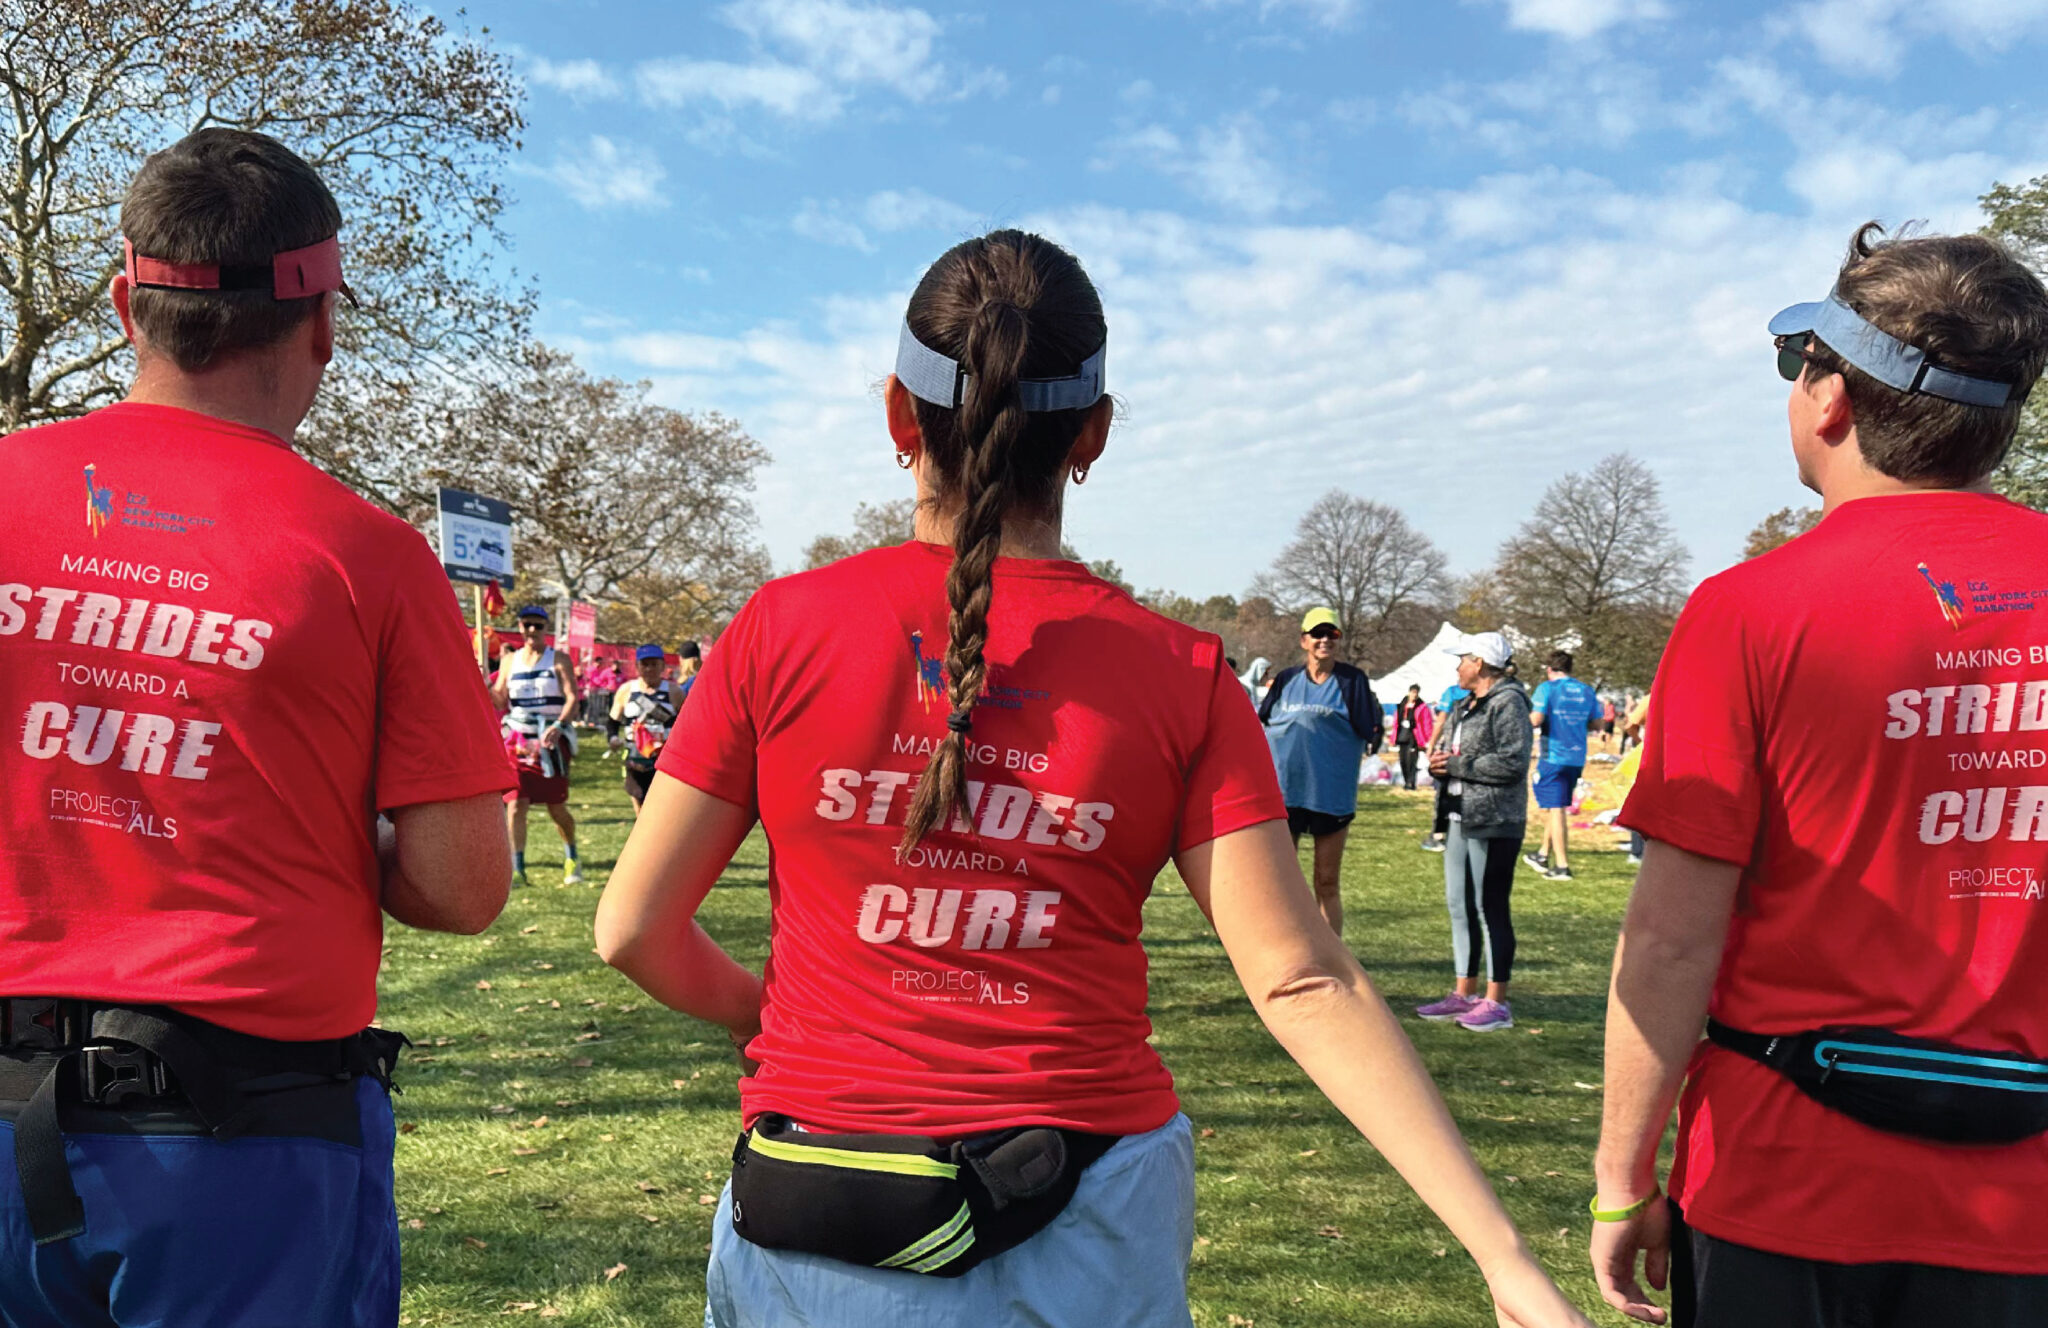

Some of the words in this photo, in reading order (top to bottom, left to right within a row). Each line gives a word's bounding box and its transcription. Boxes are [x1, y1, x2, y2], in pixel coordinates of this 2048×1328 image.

[121, 517, 187, 534] MARATHON
[154, 510, 185, 523] YORK
[187, 515, 215, 527] CITY
[61, 554, 161, 585] MAKING
[168, 569, 209, 591] BIG
[1974, 602, 2035, 614] MARATHON
[2000, 591, 2027, 601] YORK
[0, 582, 273, 670] STRIDES
[1935, 647, 2022, 671] MAKING
[57, 662, 166, 695] TOWARD
[173, 679, 189, 700] A
[19, 701, 222, 780] CURE
[892, 732, 997, 765] MANG
[1005, 748, 1049, 773] BIG
[1947, 749, 2047, 772] TOWARD
[51, 788, 141, 819] PROJECT
[127, 813, 178, 839] ALS
[815, 768, 1115, 852] STIDES
[891, 846, 1004, 873] TOWARD
[1013, 857, 1029, 876] A
[1949, 867, 2033, 888] PROJECT
[854, 883, 1062, 950] CURE
[892, 969, 986, 990] PROJECT
[978, 981, 1030, 1005] ALS
